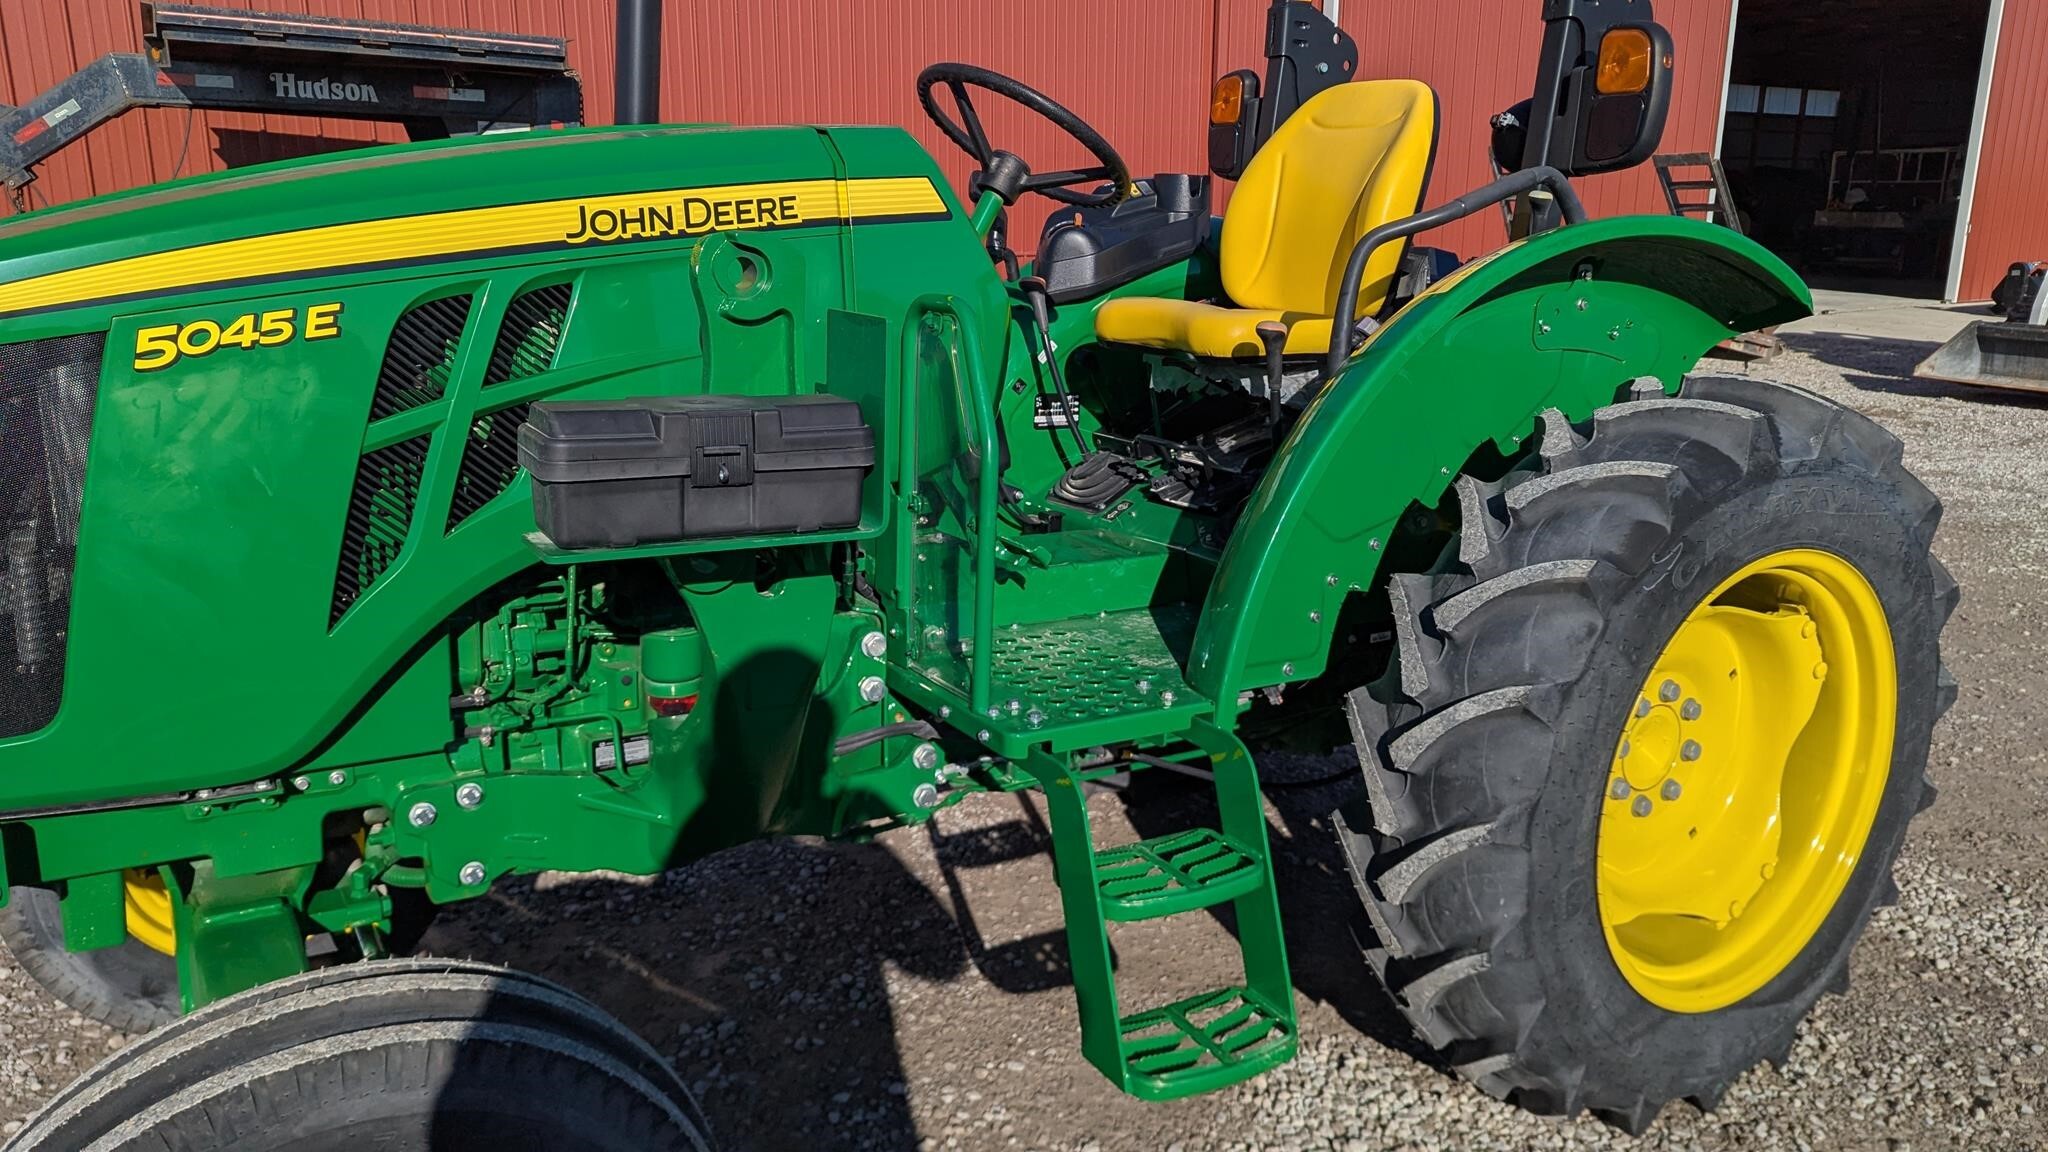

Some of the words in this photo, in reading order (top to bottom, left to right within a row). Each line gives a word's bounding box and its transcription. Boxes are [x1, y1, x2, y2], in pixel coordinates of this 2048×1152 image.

[269, 72, 379, 103] Hudson
[565, 204, 674, 240] JOHN
[683, 195, 799, 230] DEERE
